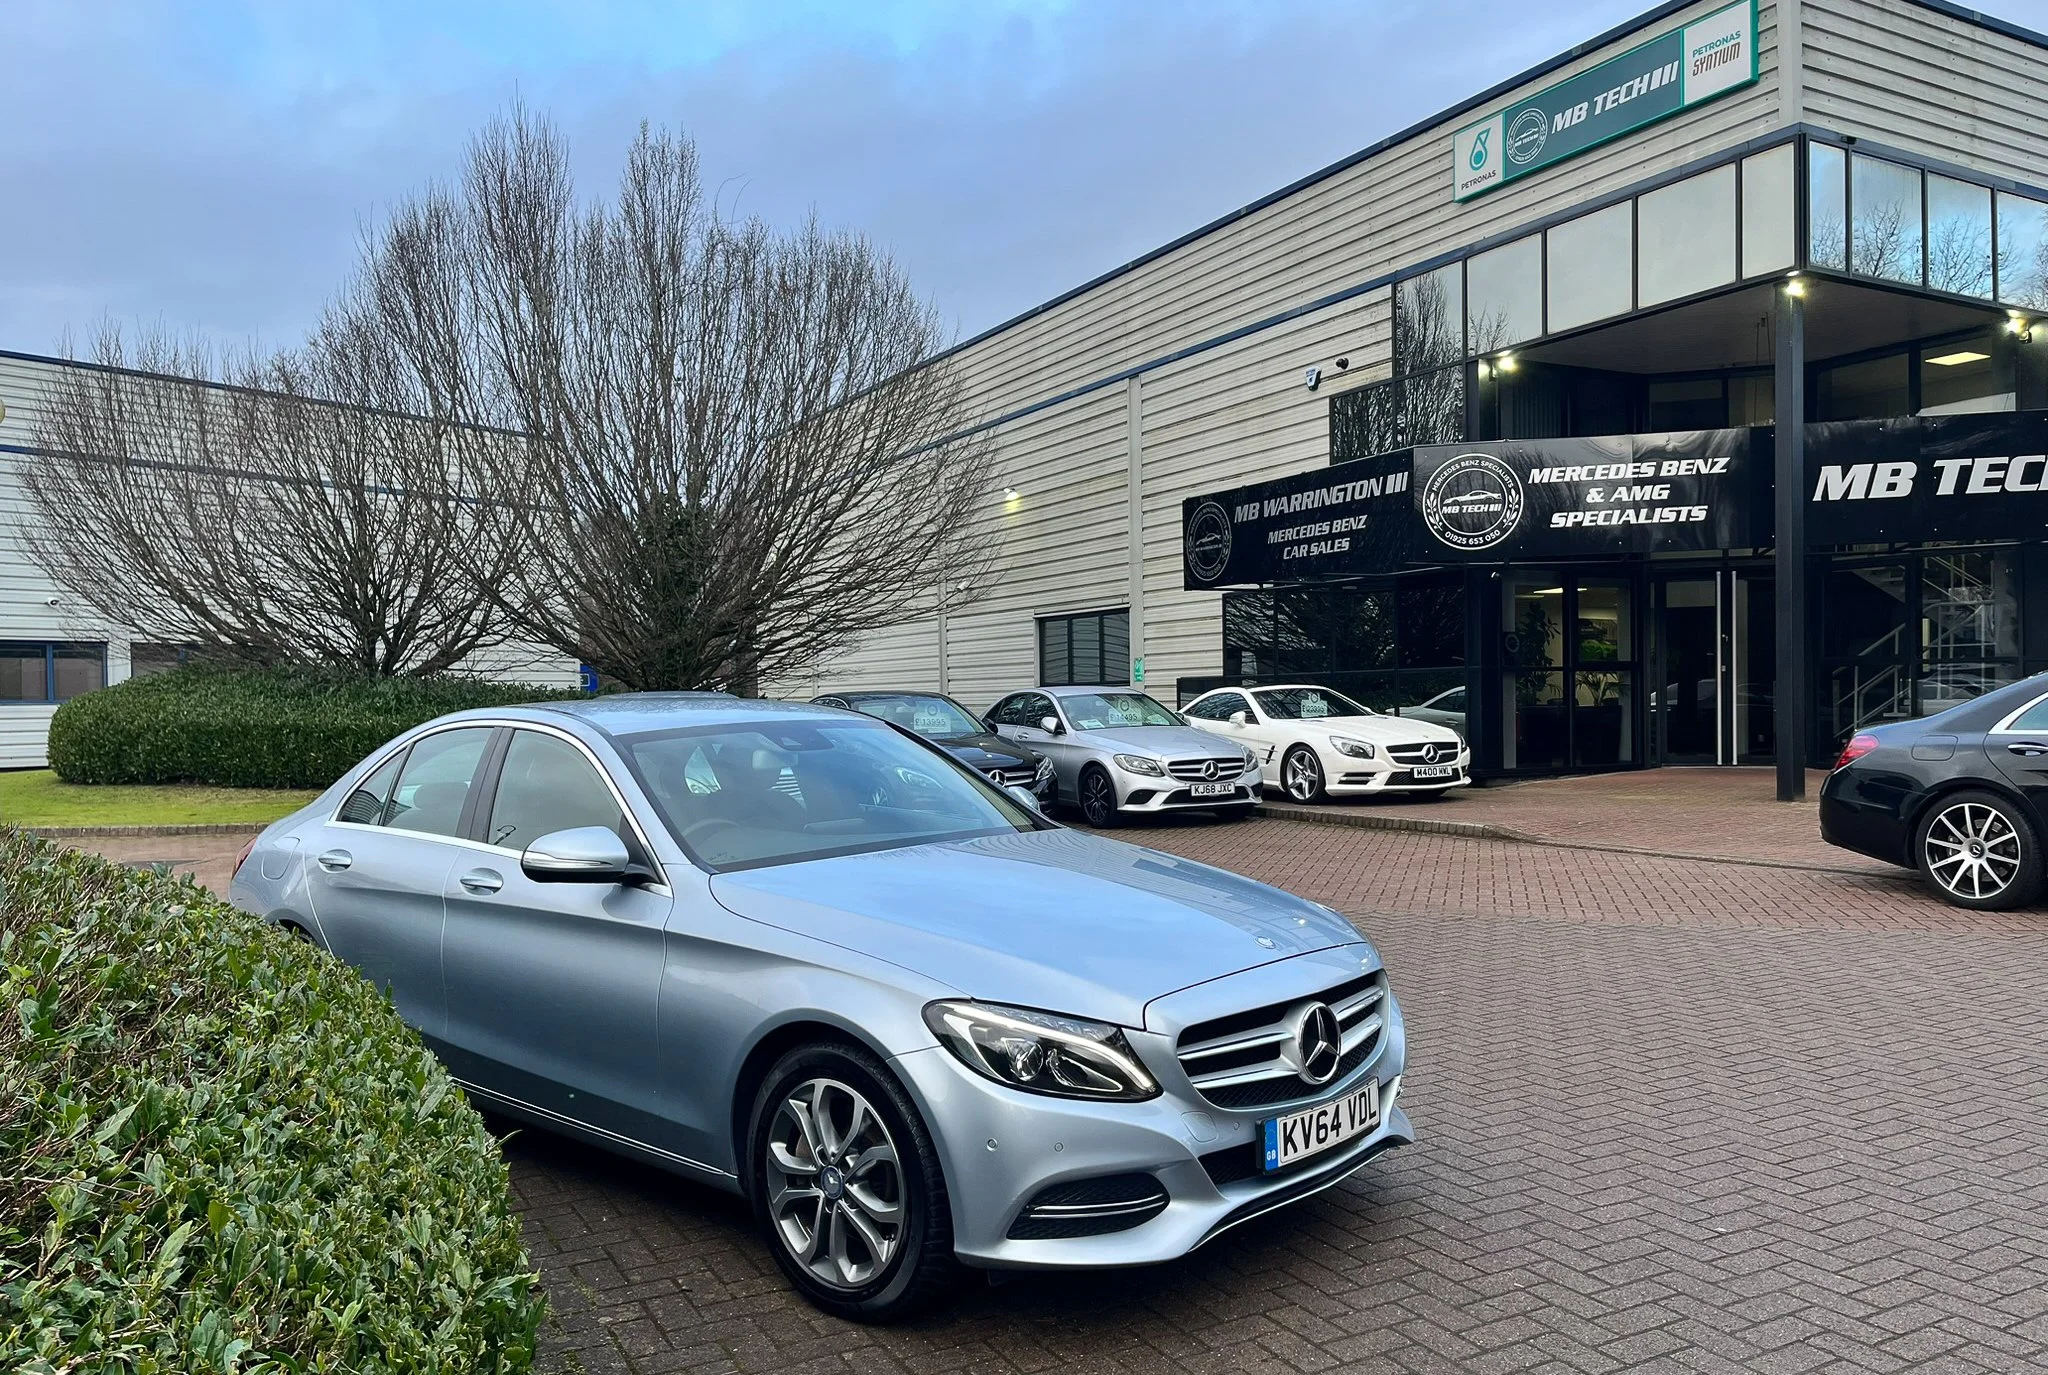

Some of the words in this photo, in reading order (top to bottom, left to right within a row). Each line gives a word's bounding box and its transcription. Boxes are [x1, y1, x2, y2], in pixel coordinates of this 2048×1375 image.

[1692, 30, 1741, 58] PETRONAS
[1692, 42, 1741, 77] SYNTIUM
[1551, 101, 1589, 134] MB
[1461, 169, 1496, 191] PETRONAS
[1431, 463, 1461, 492] MERCEDES
[1460, 459, 1480, 468] BENZ
[1480, 460, 1515, 489] SPECIALISTS
[1527, 461, 1660, 484] MERCEDES
[1659, 457, 1731, 478] BENZ
[1812, 461, 1918, 502] MB
[1933, 454, 2048, 496] TEC
[1234, 502, 1260, 524] MB
[1263, 476, 1384, 518] WARRINGTON
[1585, 487, 1605, 503] &
[1610, 483, 1671, 502] AMG
[1441, 505, 1460, 514] MB
[1549, 505, 1708, 528] SPECIALISTS
[1267, 520, 1331, 545] MERCEDES
[1331, 514, 1368, 534] BENZ
[1444, 531, 1467, 545] 01925
[1468, 537, 1484, 545] 653
[1484, 529, 1501, 541] 050
[1283, 544, 1308, 560] CAR
[1309, 537, 1351, 556] SALES
[1416, 768, 1438, 777] M400
[1194, 784, 1216, 794] KJ68
[1217, 783, 1232, 793] JXC
[1282, 1103, 1342, 1158] KV64
[1347, 1087, 1377, 1131] VDL
[1266, 1149, 1277, 1161] GB
